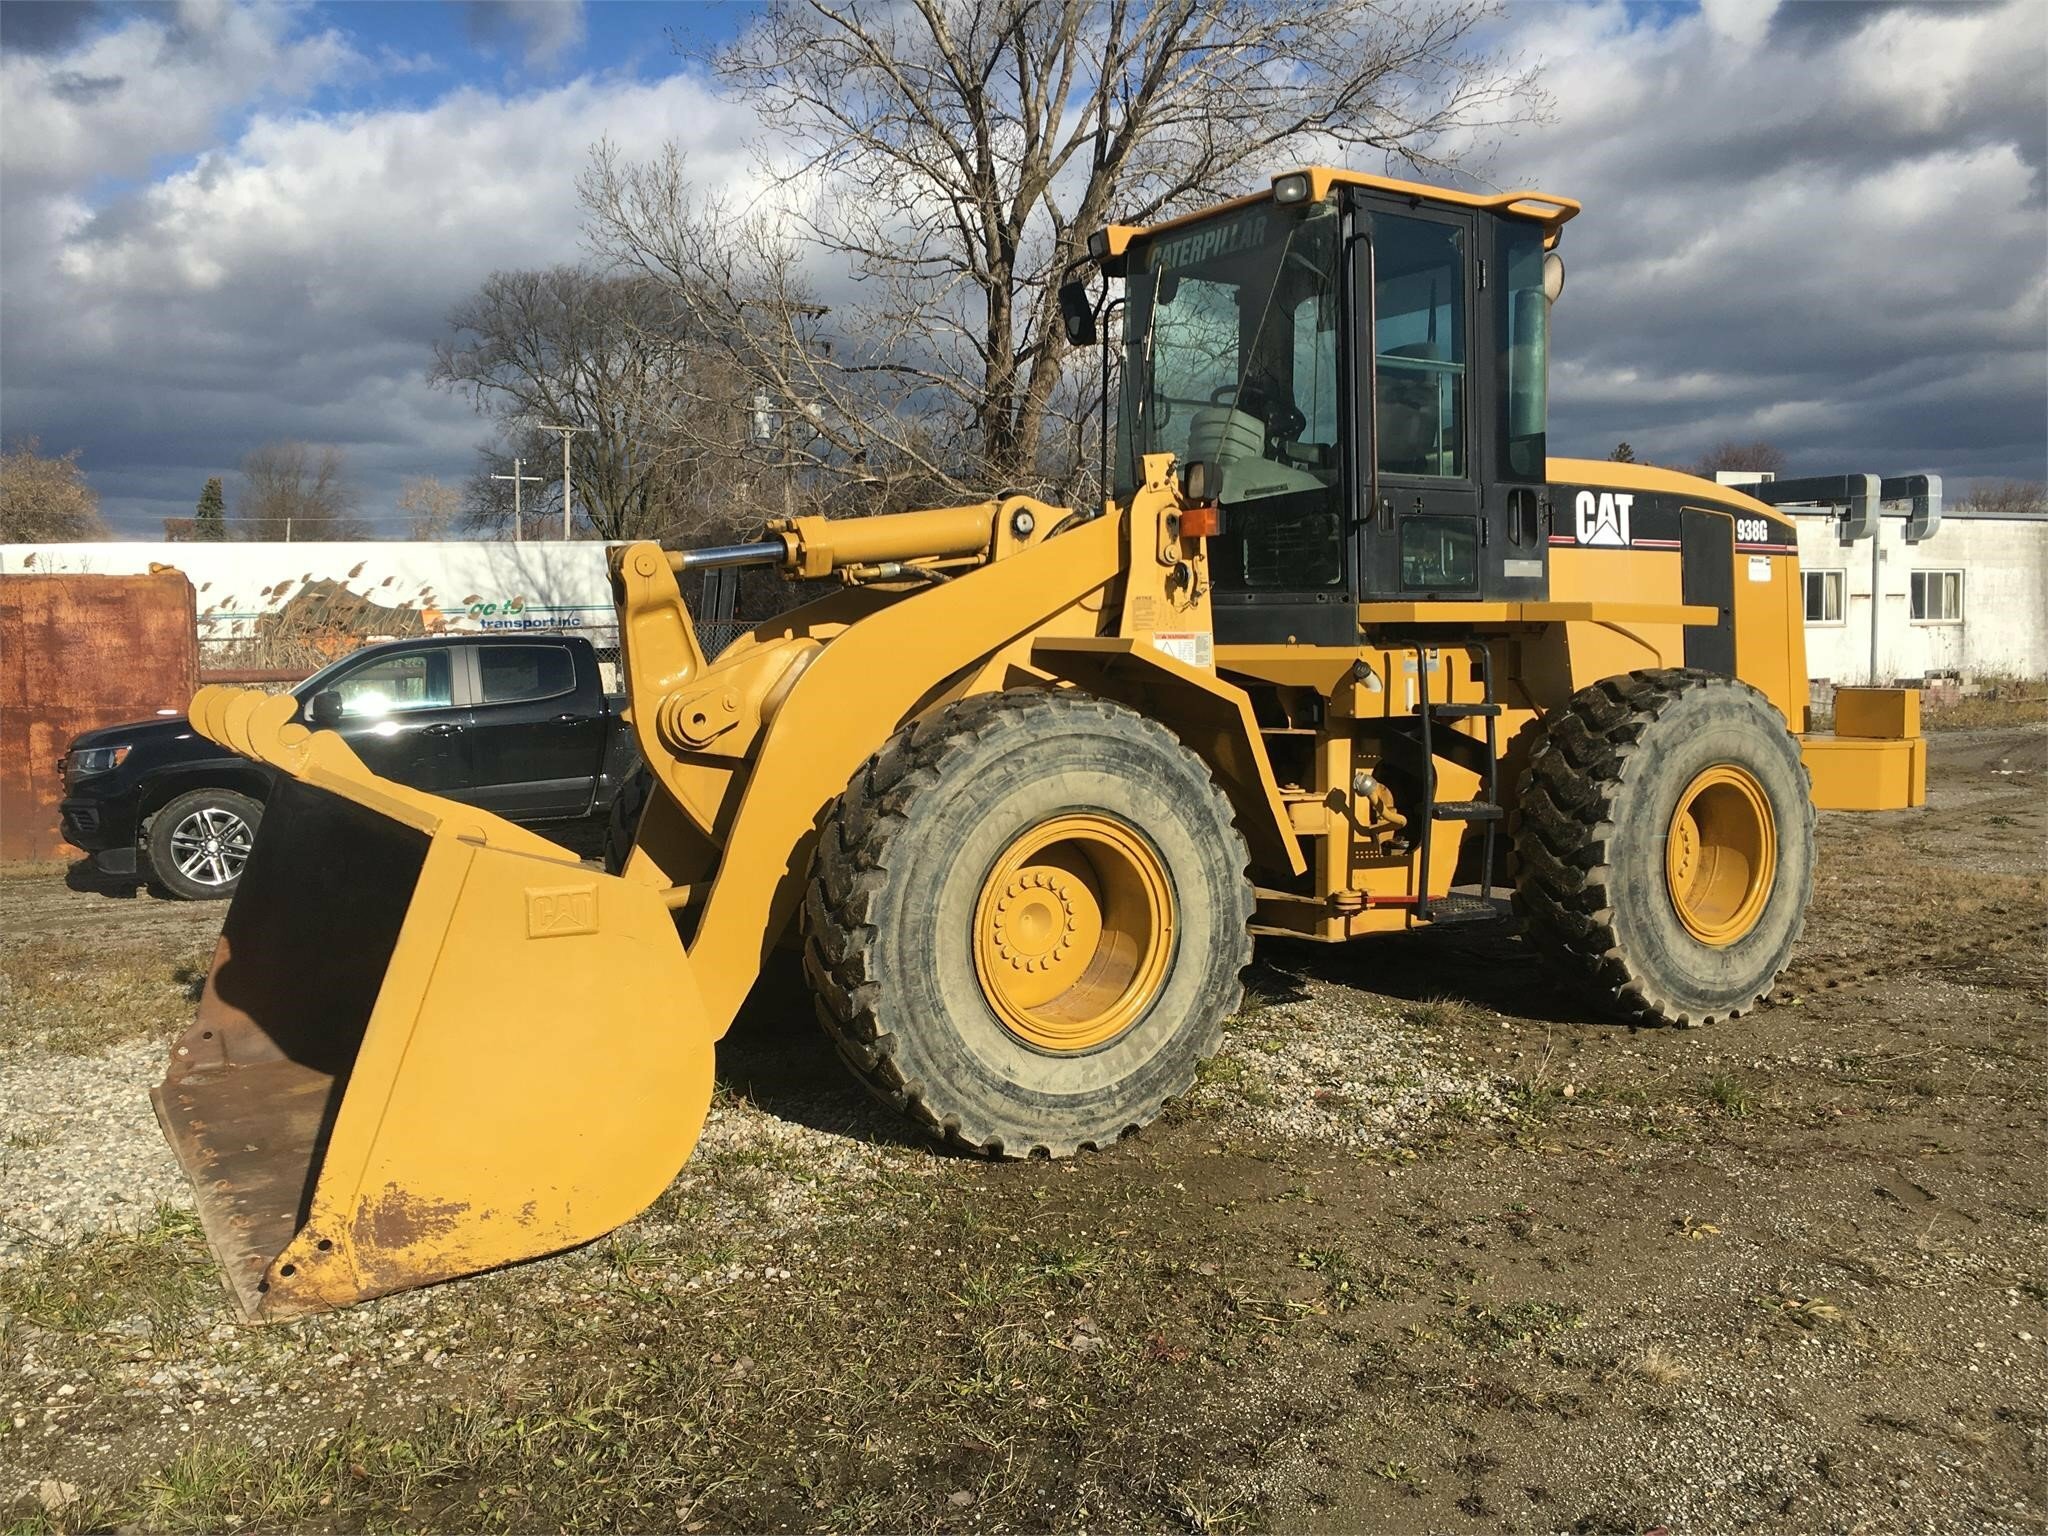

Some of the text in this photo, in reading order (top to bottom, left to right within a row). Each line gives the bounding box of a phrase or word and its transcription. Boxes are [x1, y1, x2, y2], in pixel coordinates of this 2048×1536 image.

[1150, 216, 1268, 274] CATERPILLAR
[1576, 490, 1634, 545] CAT
[1737, 519, 1768, 541] 938G
[480, 619, 555, 629] transport
[533, 892, 592, 930] CAT
